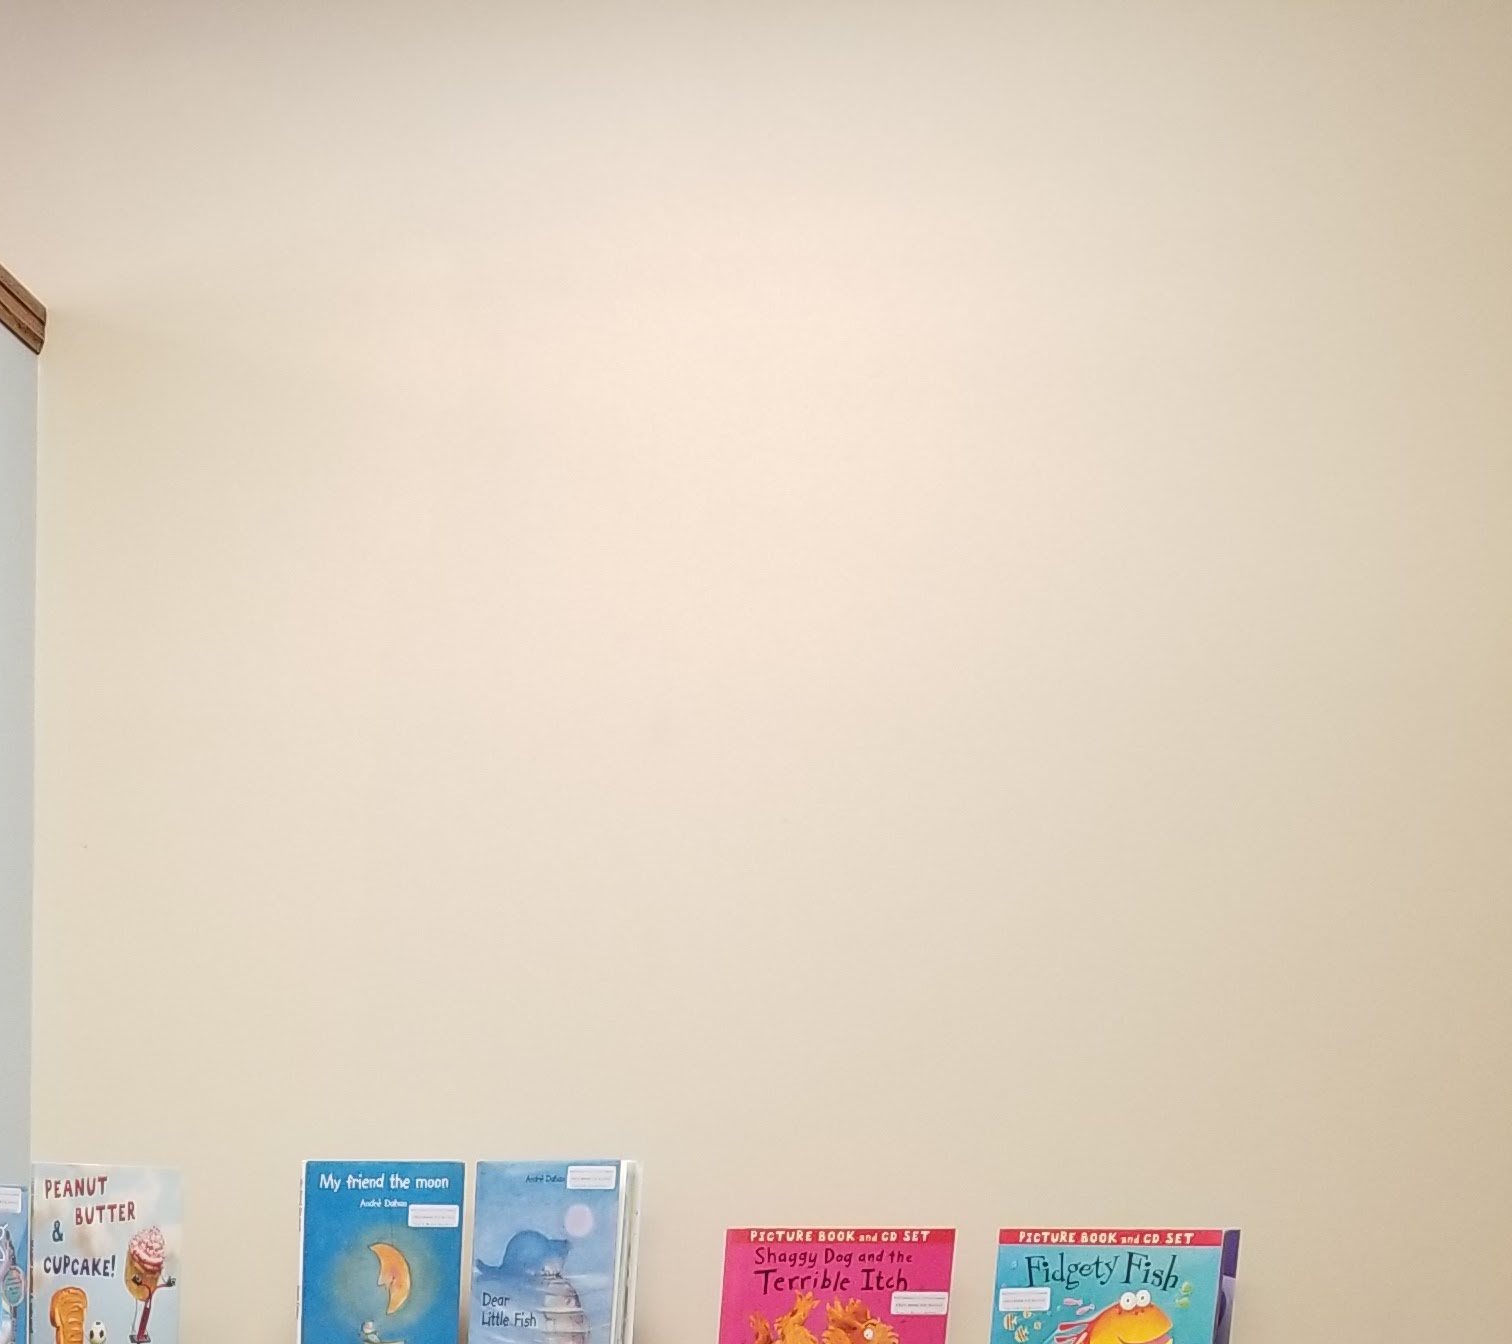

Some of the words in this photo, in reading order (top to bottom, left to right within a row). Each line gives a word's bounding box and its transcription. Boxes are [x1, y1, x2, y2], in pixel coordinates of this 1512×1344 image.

[44, 1176, 108, 1200] PEANUT
[319, 1174, 341, 1192] My
[346, 1173, 385, 1190] friend
[390, 1173, 410, 1189] the
[416, 1177, 449, 1190] moon
[75, 1201, 136, 1226] BUTTER
[52, 1220, 65, 1242] &
[750, 1230, 813, 1242] PICTURE
[818, 1230, 855, 1242] BOOK
[859, 1231, 878, 1242] and
[881, 1231, 897, 1242] CD
[903, 1230, 930, 1242] SET
[1019, 1231, 1076, 1243] PICTURE
[1081, 1232, 1117, 1244] BOOK
[1121, 1234, 1139, 1245] and
[1143, 1233, 1160, 1244] CD
[1166, 1232, 1195, 1244] SET
[43, 1254, 116, 1279] CUPCAKE!
[754, 1247, 818, 1268] Shaggy
[824, 1248, 852, 1268] Dog
[858, 1250, 884, 1263] and
[888, 1250, 913, 1263] the
[754, 1269, 851, 1295] Terrible
[861, 1268, 908, 1292] Itch
[1025, 1252, 1120, 1290] Fidgety
[1120, 1251, 1179, 1291] Fish
[482, 1292, 510, 1307] Dear
[481, 1312, 509, 1327] Little
[514, 1312, 537, 1328] Fish
